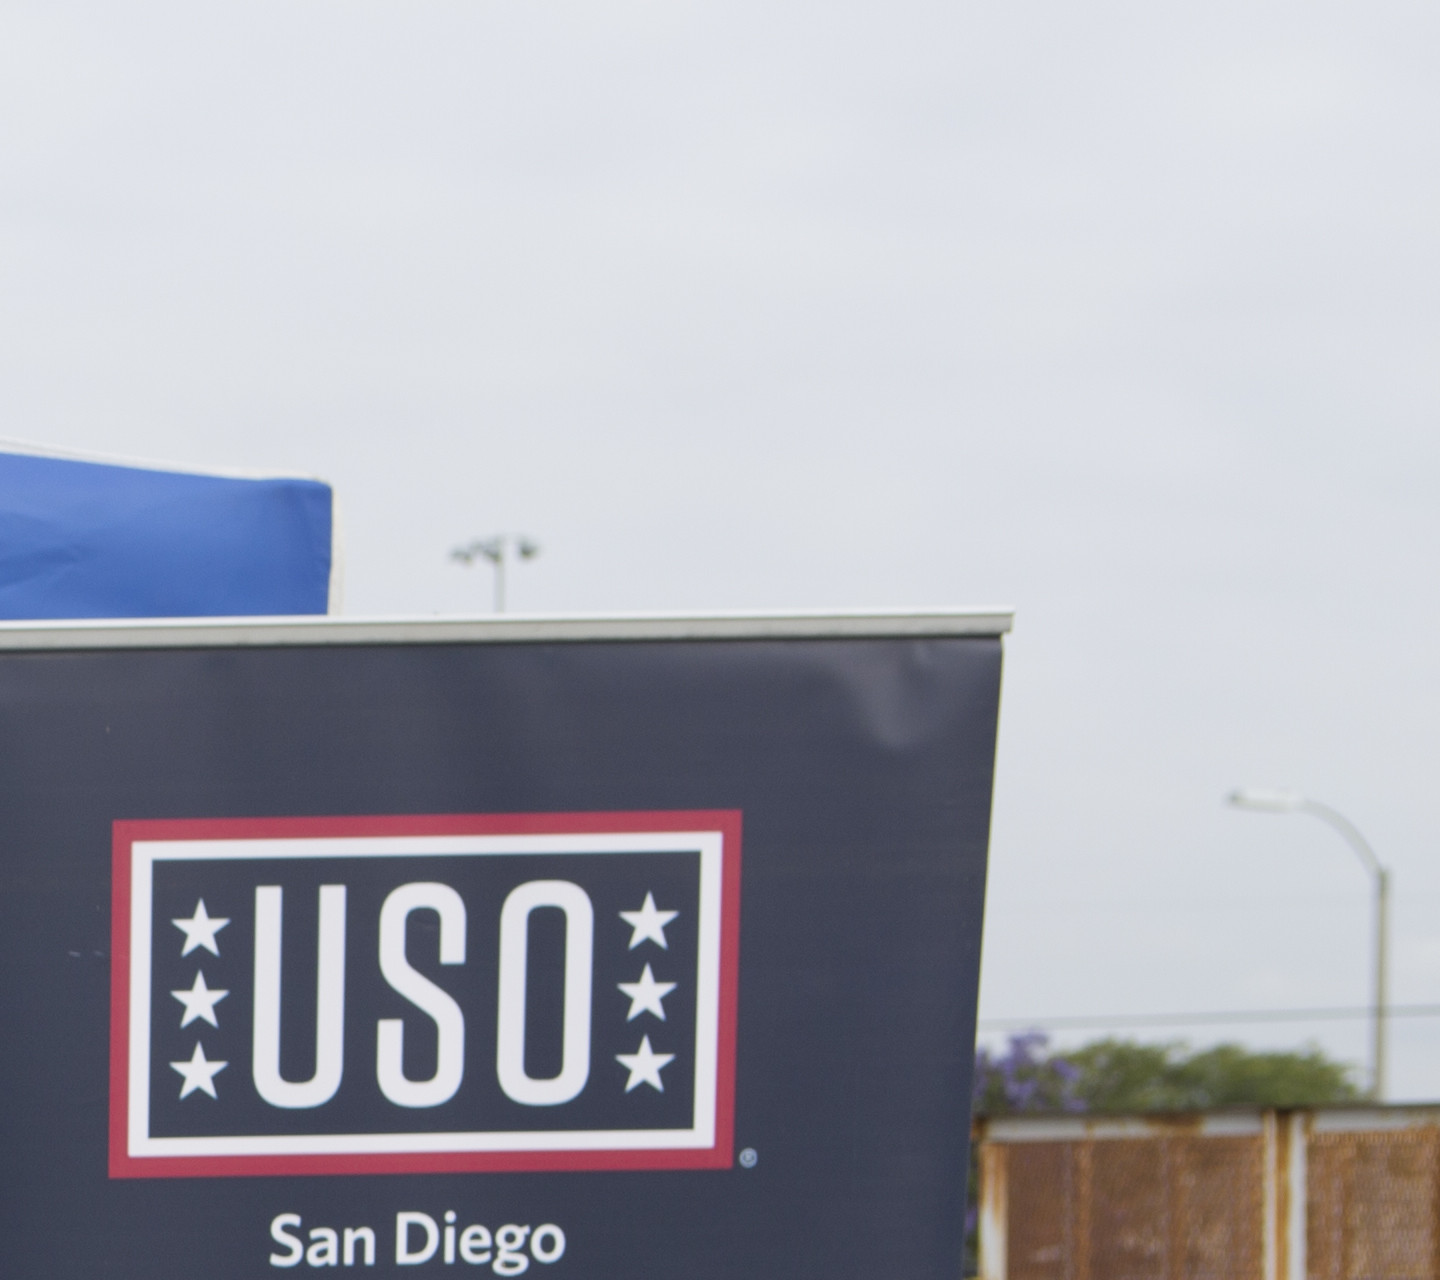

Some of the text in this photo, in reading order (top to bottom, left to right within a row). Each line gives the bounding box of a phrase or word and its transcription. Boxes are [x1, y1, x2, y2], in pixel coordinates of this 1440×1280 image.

[253, 880, 593, 1108] USO
[270, 1211, 565, 1276] San Diego
